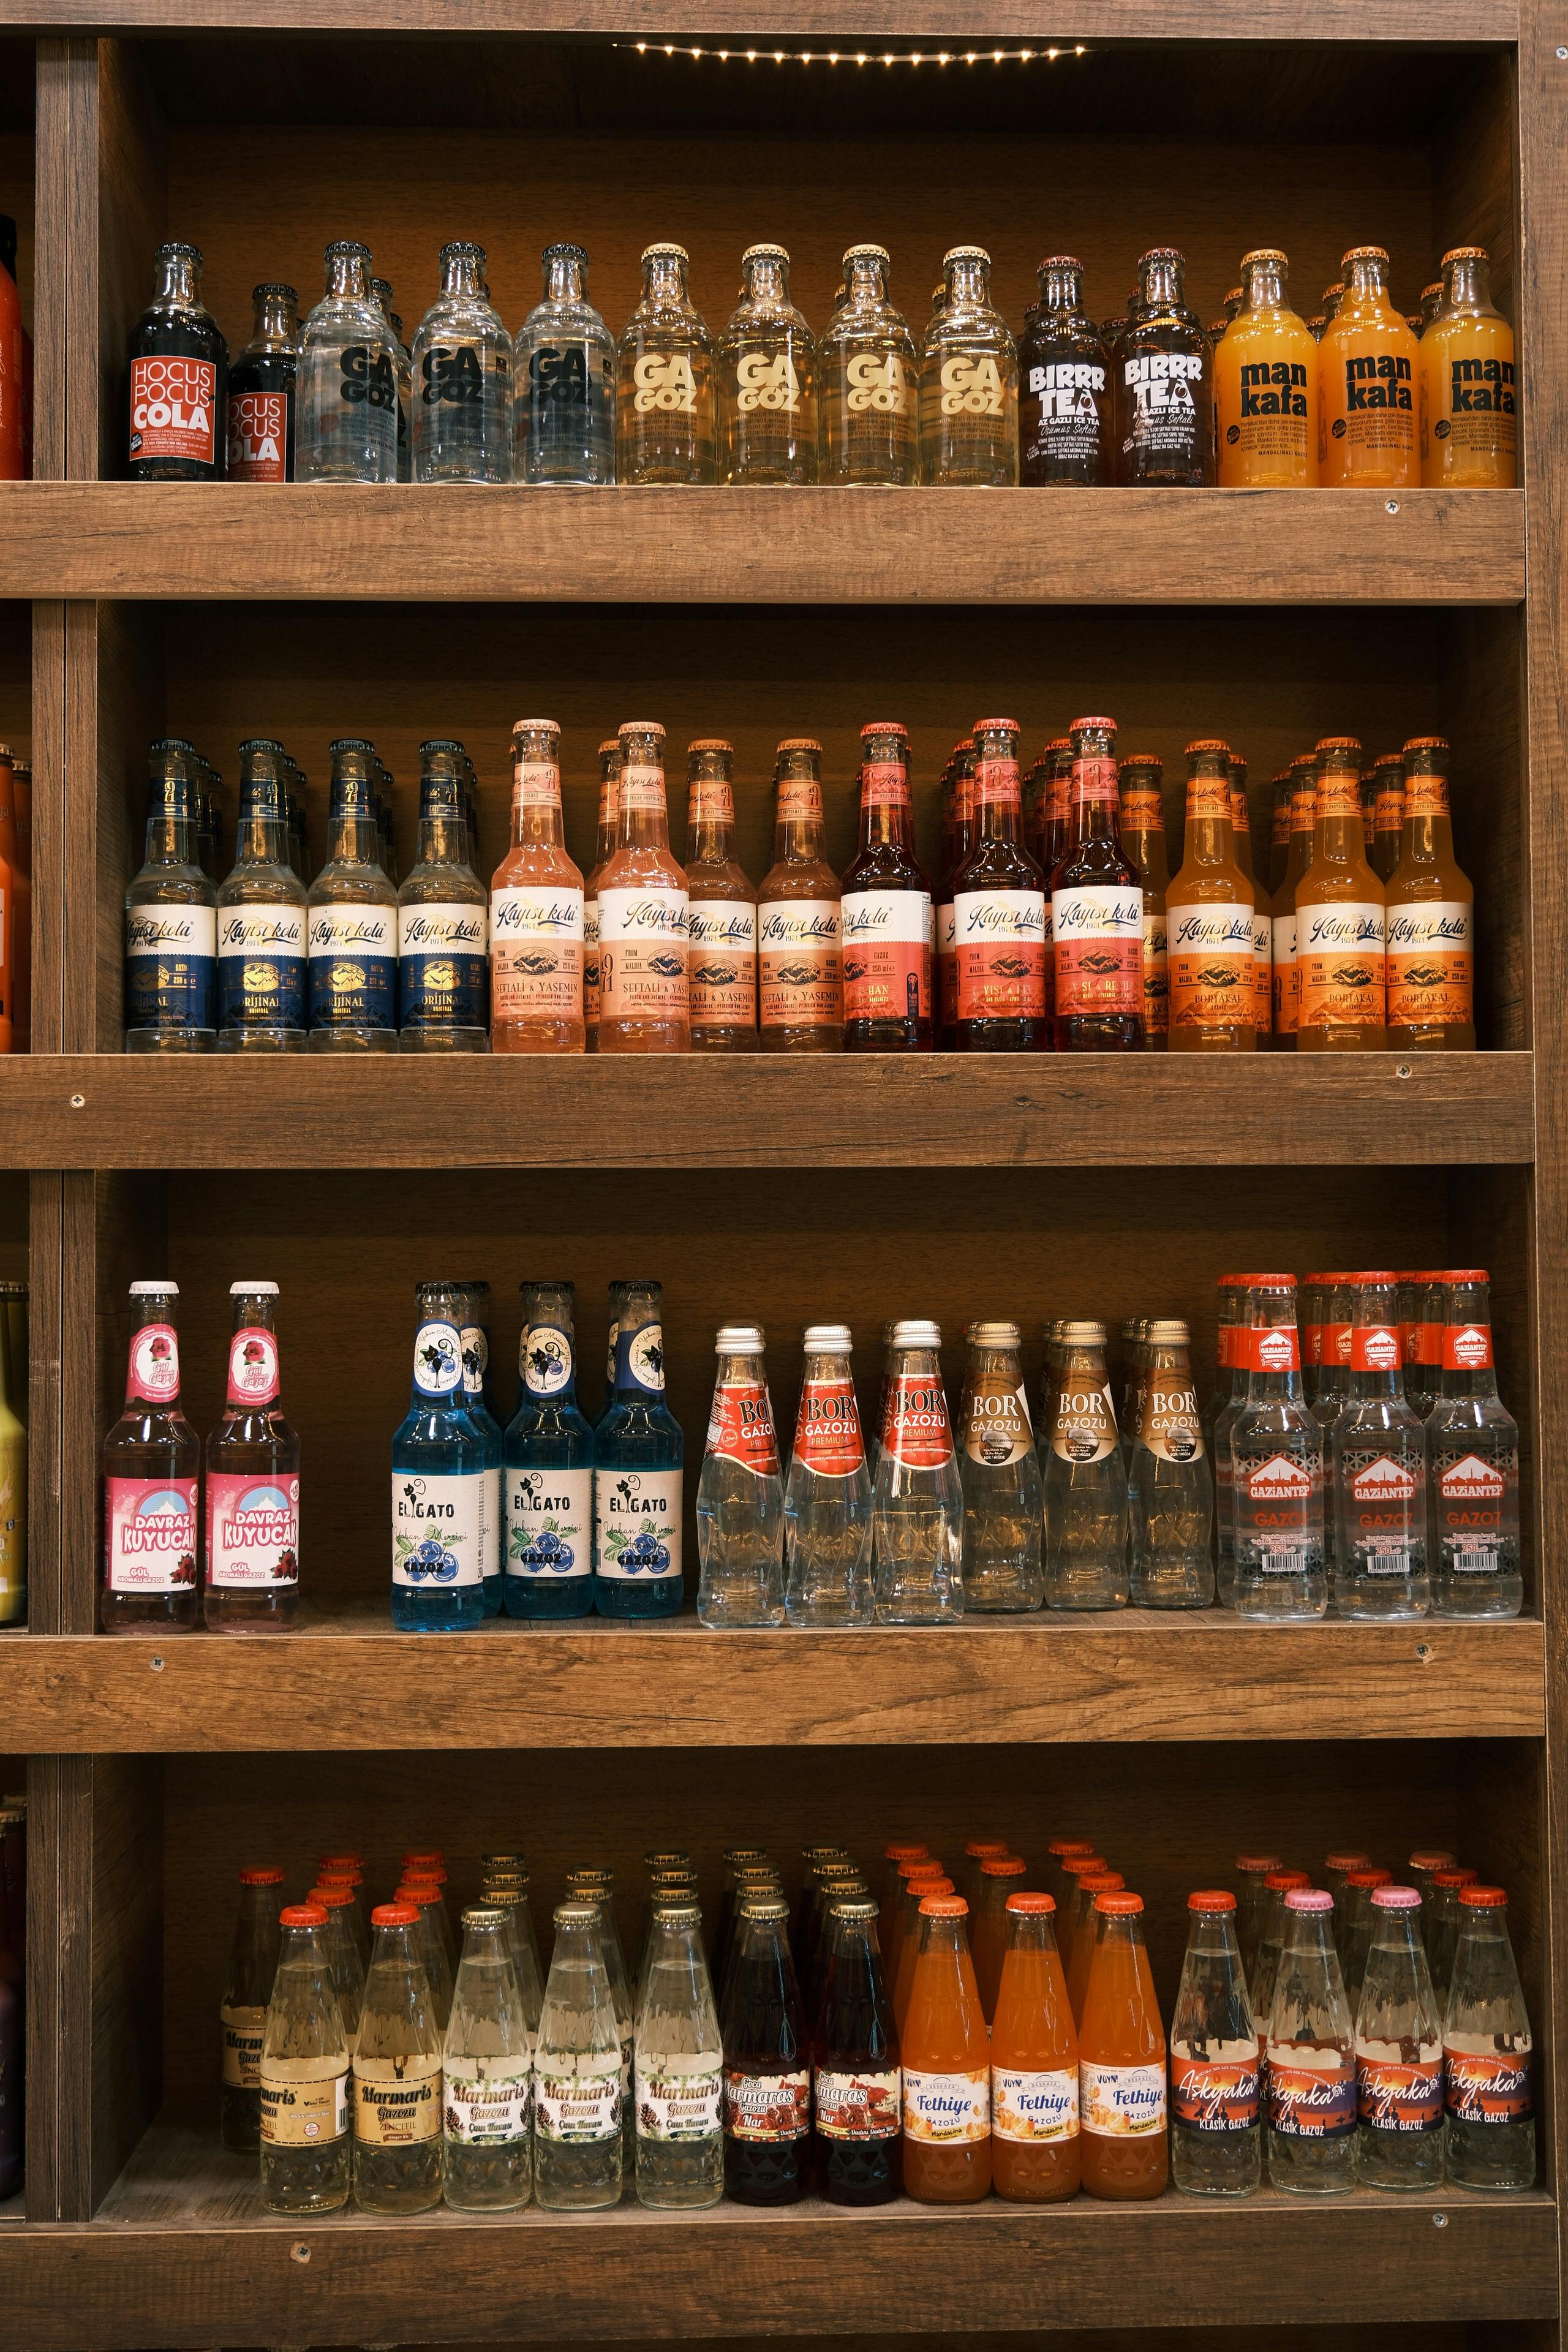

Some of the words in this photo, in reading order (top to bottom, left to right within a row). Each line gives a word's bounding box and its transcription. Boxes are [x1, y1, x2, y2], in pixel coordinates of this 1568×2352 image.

[340, 347, 395, 392] GA
[422, 347, 483, 382] GA
[529, 347, 592, 384] GA
[633, 354, 697, 391] GA
[736, 353, 801, 391] GA
[846, 354, 907, 393] GA
[1125, 354, 1202, 386] BIRRR
[1346, 355, 1412, 382] man
[1452, 358, 1515, 386] man
[135, 362, 211, 388] HOCUS
[940, 357, 1004, 394] GA
[1029, 364, 1105, 393] BIRRR
[1240, 362, 1307, 388] man
[135, 383, 211, 409] POCUS
[341, 380, 395, 414] GOZ
[423, 379, 484, 405] GOZ
[530, 379, 592, 405] GOZ
[634, 387, 698, 413] GOZ
[737, 386, 801, 413] GOZ
[847, 388, 908, 415] GOZ
[1133, 379, 1194, 408] TEA
[1241, 385, 1308, 418] kafa
[1346, 378, 1412, 412] kafa
[1452, 382, 1515, 416] kafa
[941, 391, 1005, 417] GOZ
[1039, 388, 1098, 418] TEA
[134, 403, 211, 434] COLA
[1087, 417, 1100, 426] TEA
[1167, 414, 1193, 424] Şeftali
[1073, 424, 1098, 435] Şeftali
[496, 901, 545, 929] Kayısı
[543, 903, 578, 924] kola
[620, 900, 677, 929] Kayısı
[853, 907, 890, 927] kola
[967, 904, 1020, 932] Kayısı
[1058, 901, 1108, 930] Kayısı
[1107, 902, 1140, 923] kola
[222, 919, 267, 946] Kayısı
[268, 920, 301, 941] kola
[310, 919, 350, 946] Kayısı
[404, 918, 451, 944] Kayısı
[450, 919, 483, 940] kola
[761, 915, 804, 941] Kayısı
[804, 916, 839, 936] kola
[1175, 917, 1227, 944] Kayısı
[1310, 917, 1363, 943] Kayısı
[1387, 918, 1431, 944] Kayısı
[1433, 917, 1466, 937] kola
[496, 980, 525, 993] ŞEFTALİ
[540, 980, 578, 993] YASEMİN
[623, 981, 660, 994] ŞEFTALİ
[720, 991, 753, 1003] YASEMİN
[762, 992, 788, 1004] ŞEFTALİ
[801, 991, 839, 1002] YASEMİN
[1194, 994, 1242, 1004] PORTAKAL
[1329, 993, 1376, 1003] PORTAKAL
[1401, 992, 1450, 1003] PORTAKAL
[153, 1362, 169, 1373] Gül
[149, 1373, 175, 1384] Gazoz
[806, 1395, 855, 1422] BOR
[895, 1389, 944, 1415] BOR
[973, 1395, 1019, 1417] BOR
[1058, 1392, 1106, 1415] BOR
[1152, 1392, 1197, 1414] BOR
[805, 1422, 857, 1436] GAZOZU
[894, 1414, 946, 1428] GAZOZU
[971, 1419, 1021, 1433] GAZOZU
[1057, 1416, 1107, 1430] GAZOZU
[1151, 1416, 1199, 1430] GAZOZU
[810, 1436, 848, 1446] PREMIUM
[899, 1428, 936, 1438] PREMIUM
[398, 1501, 411, 1517] EL
[416, 1502, 454, 1518] GATO
[514, 1494, 528, 1510] EL
[533, 1496, 570, 1511] GATO
[610, 1498, 625, 1512] EL
[630, 1498, 667, 1513] GATO
[135, 1515, 190, 1529] DAVRAZ
[236, 1510, 290, 1525] DAVRAZ
[1254, 1511, 1309, 1527] GAZOZ
[1359, 1513, 1414, 1529] GAZOZ
[1447, 1511, 1502, 1526] GAZOZ
[124, 1523, 195, 1553] KUYUCAK
[224, 1519, 296, 1549] KUYUCAK
[394, 1525, 421, 1543] Yaban
[521, 1553, 562, 1564] GAZOZ
[1270, 1545, 1285, 1554] 250
[231, 1562, 250, 1572] GÜL
[404, 1562, 445, 1573] GAZOZ
[617, 1555, 659, 1566] GAZOZ
[130, 1566, 149, 1577] GÜL
[544, 2081, 614, 2101] Marmaris
[649, 2079, 719, 2102] Marmaris
[742, 2076, 762, 2090] Goca
[362, 2084, 432, 2105] Marmaris
[453, 2082, 524, 2105] Marmaris
[1113, 2089, 1163, 2109] Fethiye
[377, 2106, 417, 2122] Gazozu
[469, 2105, 510, 2121] Gazozu
[559, 2103, 600, 2119] Gazozu
[666, 2102, 707, 2118] Gazozu
[739, 2103, 767, 2114] Gazozu
[917, 2095, 971, 2116] Fethiye
[1017, 2094, 1071, 2114] Fethiye
[1123, 2107, 1156, 2119] GAZOZU
[743, 2114, 764, 2128] Nar
[820, 2109, 835, 2124] Nar
[926, 2116, 960, 2126] GAZOZU
[1028, 2113, 1061, 2125] GAZOZU
[1199, 2117, 1226, 2130] KLASİK
[1229, 2116, 1250, 2130] GAZOZ
[1371, 2116, 1396, 2130] KLASİK
[1399, 2119, 1424, 2131] GAZOZ
[1457, 2107, 1482, 2122] KLASİK
[1484, 2112, 1509, 2123] GAZOZ
[379, 2120, 417, 2132] ZENCEFİL
[1275, 2118, 1297, 2134] KLASİK
[1299, 2125, 1325, 2136] GAZOZ
